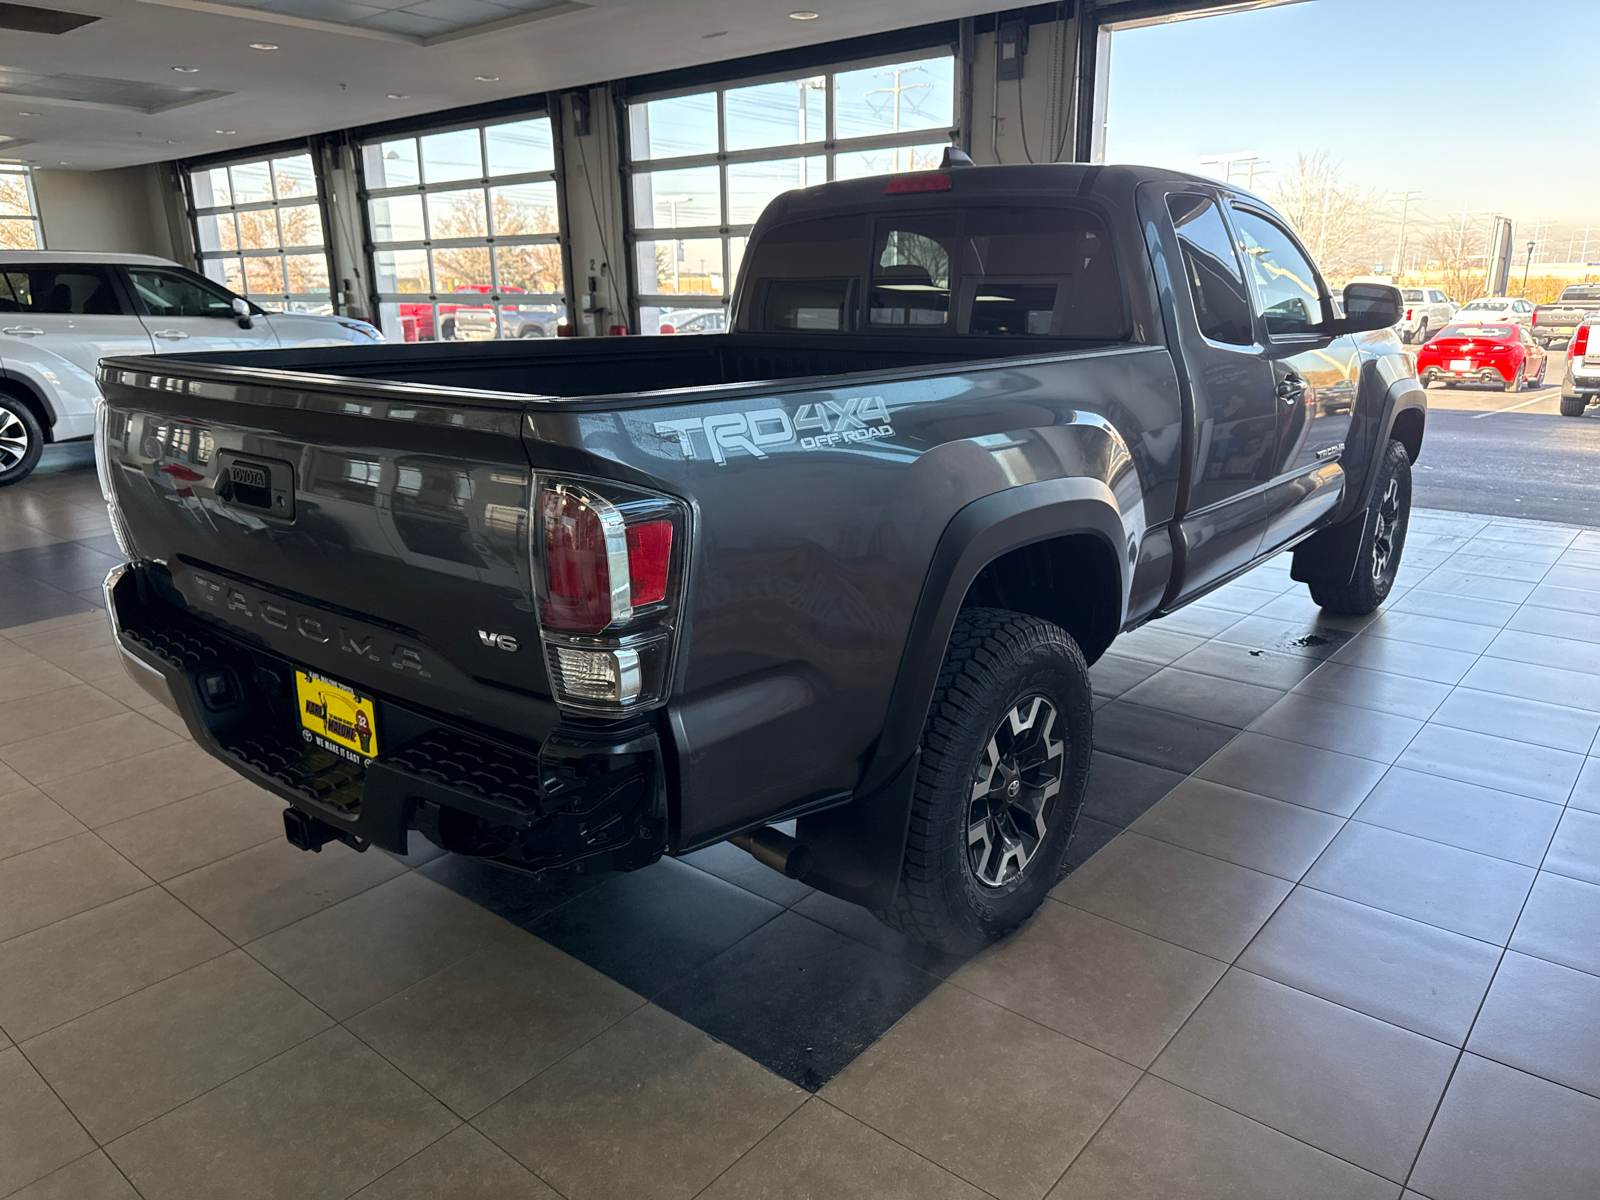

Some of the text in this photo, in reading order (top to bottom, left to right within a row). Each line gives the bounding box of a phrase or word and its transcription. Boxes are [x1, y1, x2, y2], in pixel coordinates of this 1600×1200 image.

[590, 258, 596, 271] 2
[653, 408, 797, 466] TRD
[800, 425, 896, 449] OFF ROAD
[231, 468, 265, 487] TOYOTA
[193, 573, 432, 678] TACOMA
[478, 629, 521, 652] V6
[305, 699, 324, 720] KARL
[328, 718, 357, 743] MALONE
[315, 736, 360, 765] WE MAKE IT EASY
